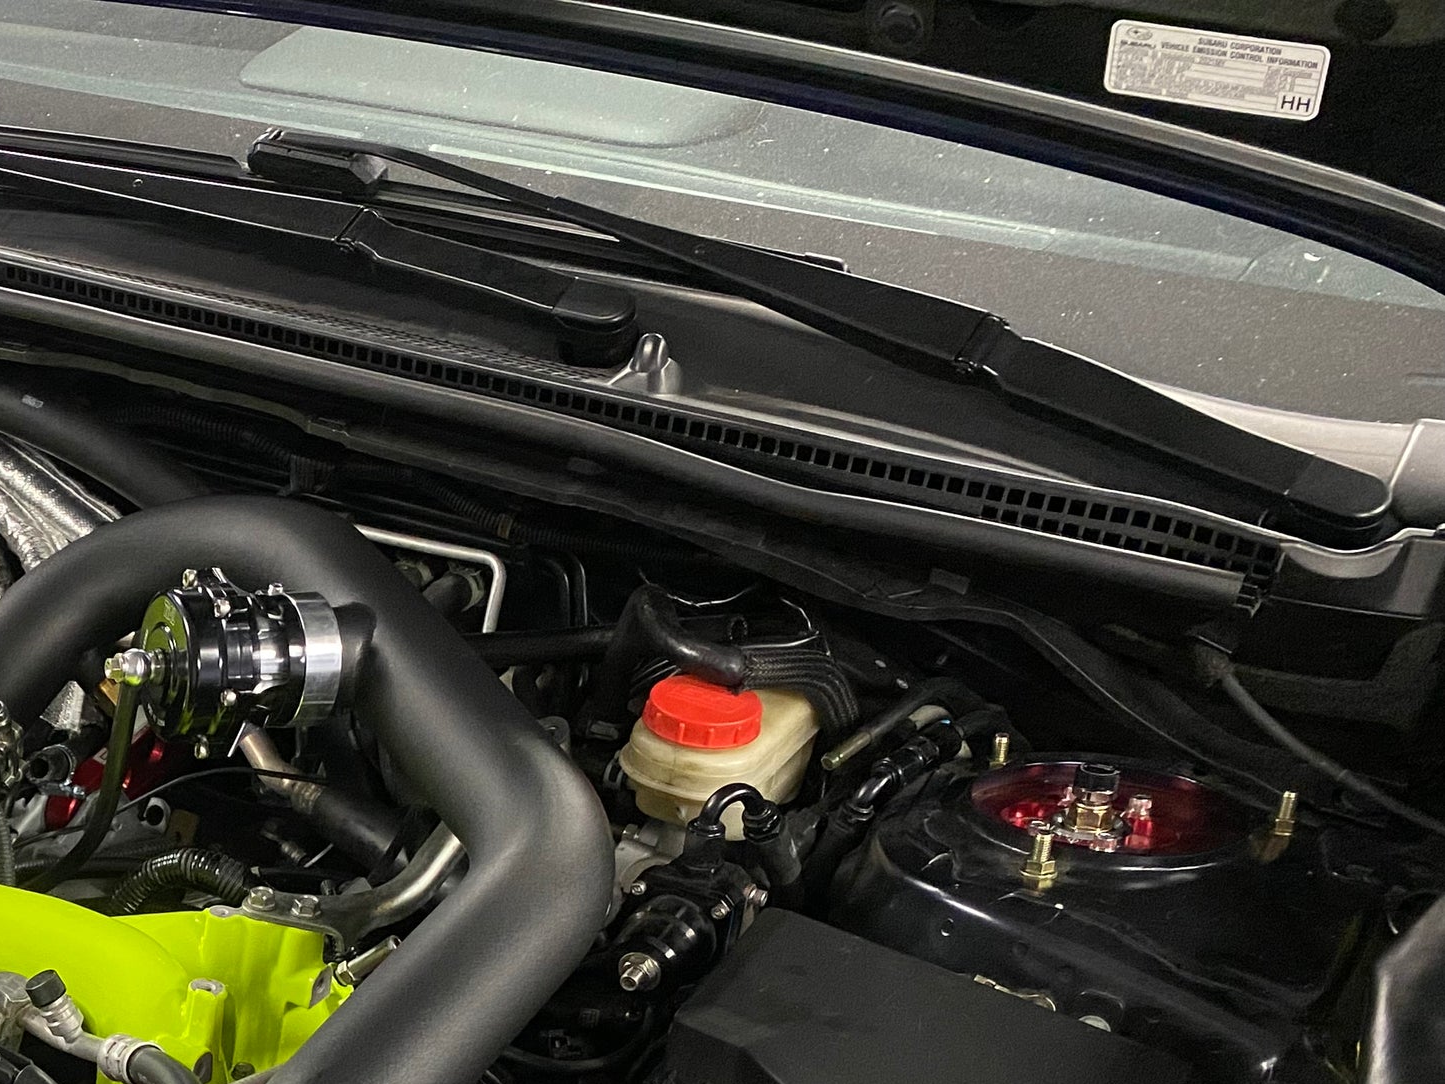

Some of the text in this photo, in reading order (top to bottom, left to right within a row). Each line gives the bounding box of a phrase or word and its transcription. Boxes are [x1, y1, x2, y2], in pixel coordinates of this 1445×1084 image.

[1161, 41, 1190, 52] VEHICLE
[1192, 46, 1228, 58] EMISSION
[1229, 51, 1264, 63] CONTROL
[1266, 56, 1319, 69] INFORMATION
[1197, 37, 1282, 56] SUBARU CORPORATION
[1280, 94, 1312, 113] HH
